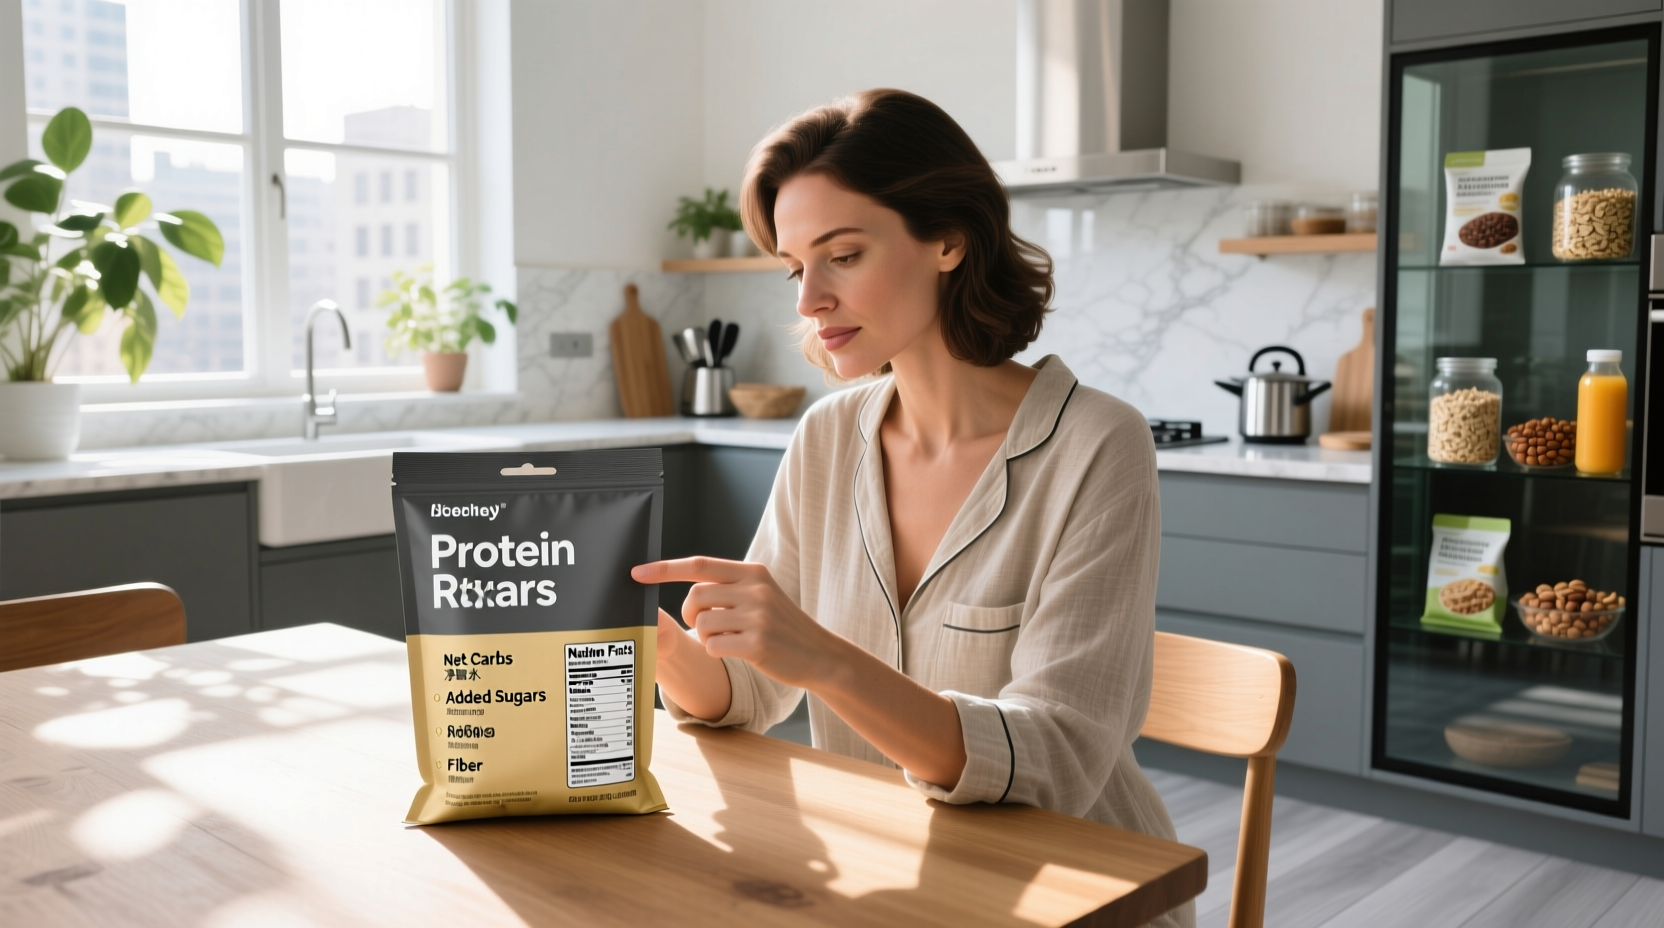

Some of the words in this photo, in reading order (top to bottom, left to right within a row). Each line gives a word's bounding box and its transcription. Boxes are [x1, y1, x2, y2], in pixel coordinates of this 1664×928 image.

[431, 531, 575, 569] Protein
[444, 653, 468, 666] Net
[470, 650, 514, 665] Carbs
[446, 689, 492, 704] Added
[495, 689, 547, 706] Sugars
